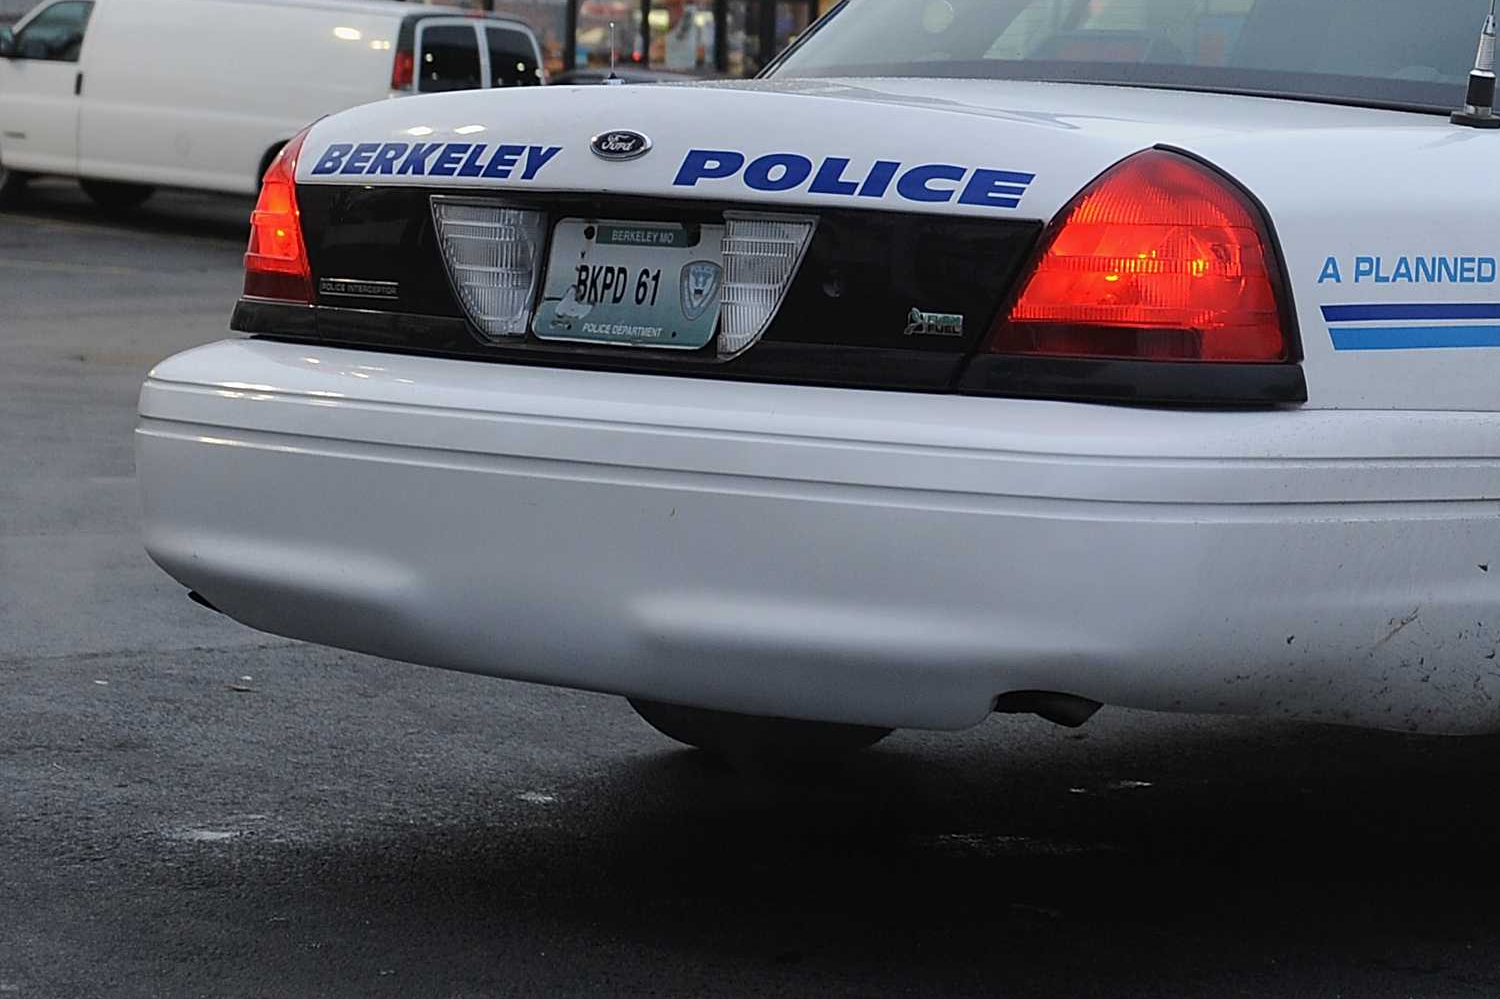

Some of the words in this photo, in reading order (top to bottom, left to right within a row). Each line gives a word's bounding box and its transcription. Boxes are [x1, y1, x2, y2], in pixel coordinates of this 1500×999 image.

[602, 134, 636, 151] Ford
[311, 143, 563, 180] BERKELEY
[672, 149, 1036, 209] POLICE
[611, 229, 658, 243] BERKELEY
[660, 232, 674, 244] MO
[1317, 257, 1342, 284] A
[1354, 256, 1496, 284] PLANNED
[576, 264, 628, 305] BKPD
[635, 267, 661, 306] 61
[582, 322, 610, 334] POLICE
[612, 324, 662, 337] DEPARTMENT
